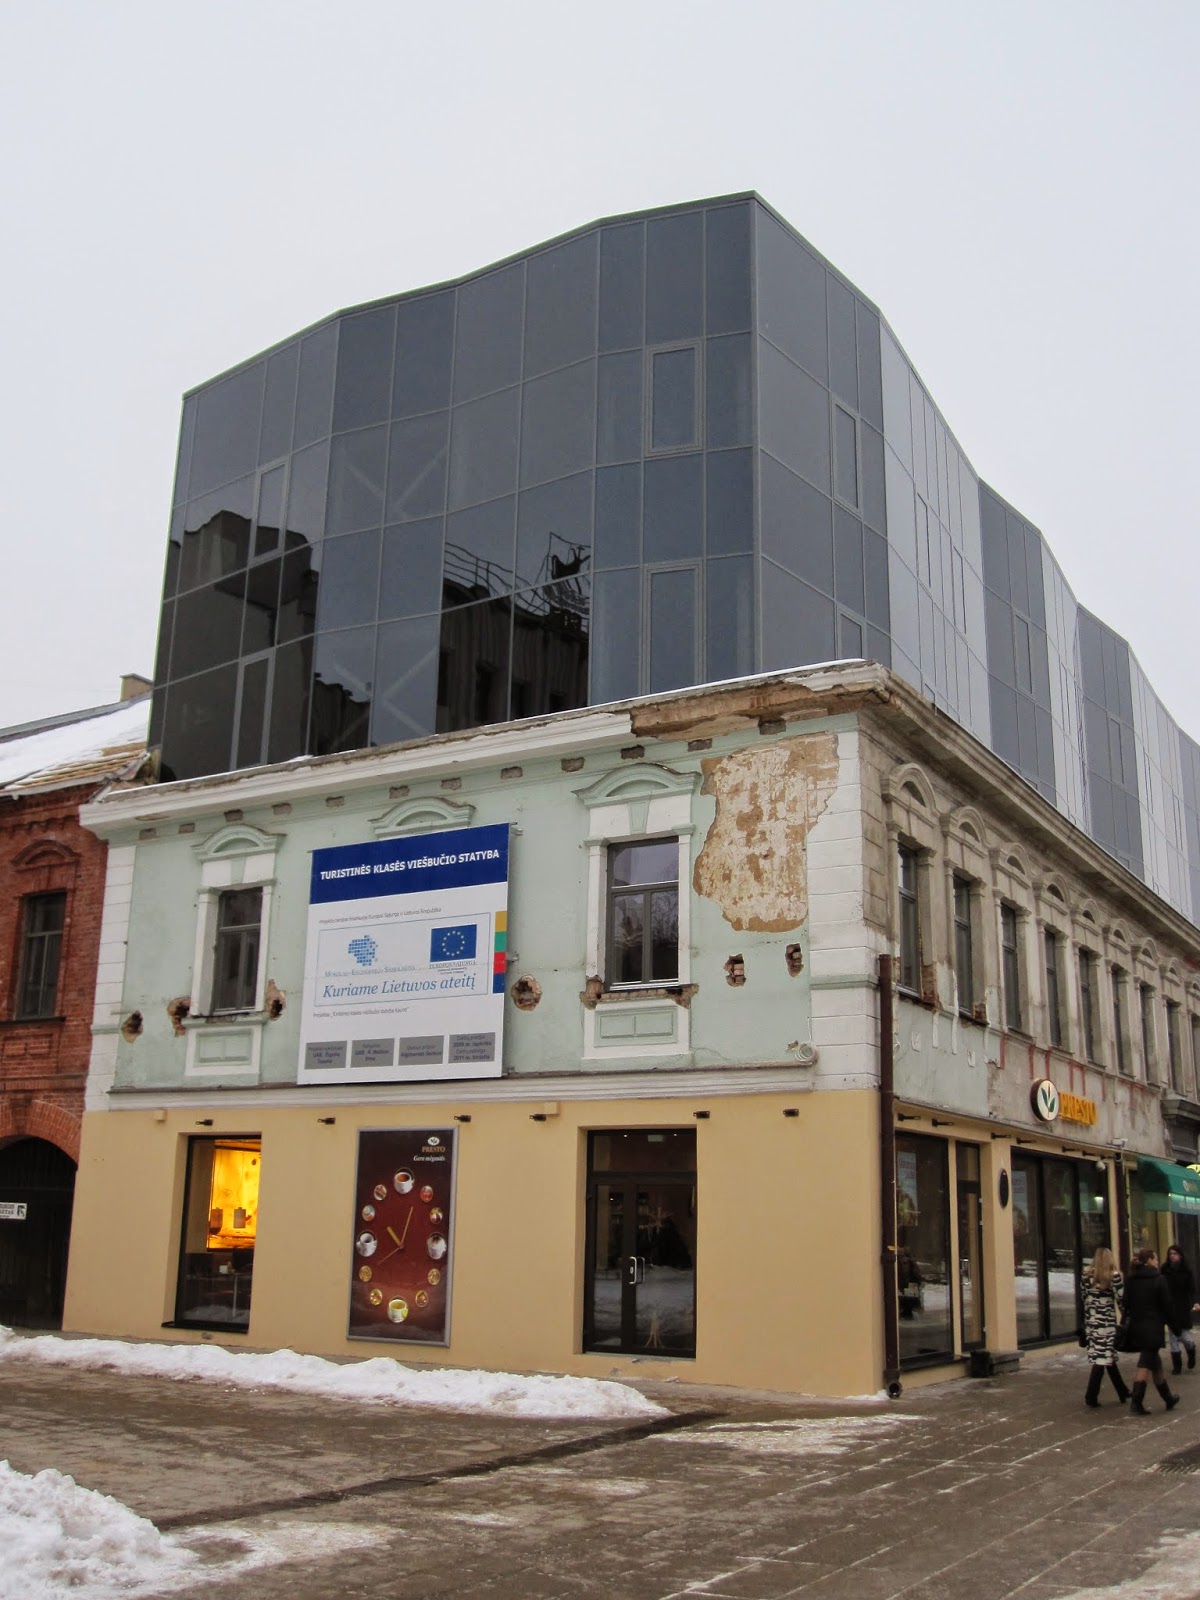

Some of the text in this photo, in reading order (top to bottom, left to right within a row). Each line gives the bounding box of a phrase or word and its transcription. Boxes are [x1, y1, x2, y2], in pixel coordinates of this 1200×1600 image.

[320, 849, 499, 880] TURISTINĖS KLASĖS VIEŠBUČIO STATYBA
[323, 973, 476, 998] Kuriame Lietuvos ateitį
[1058, 1091, 1098, 1126] PRESTO
